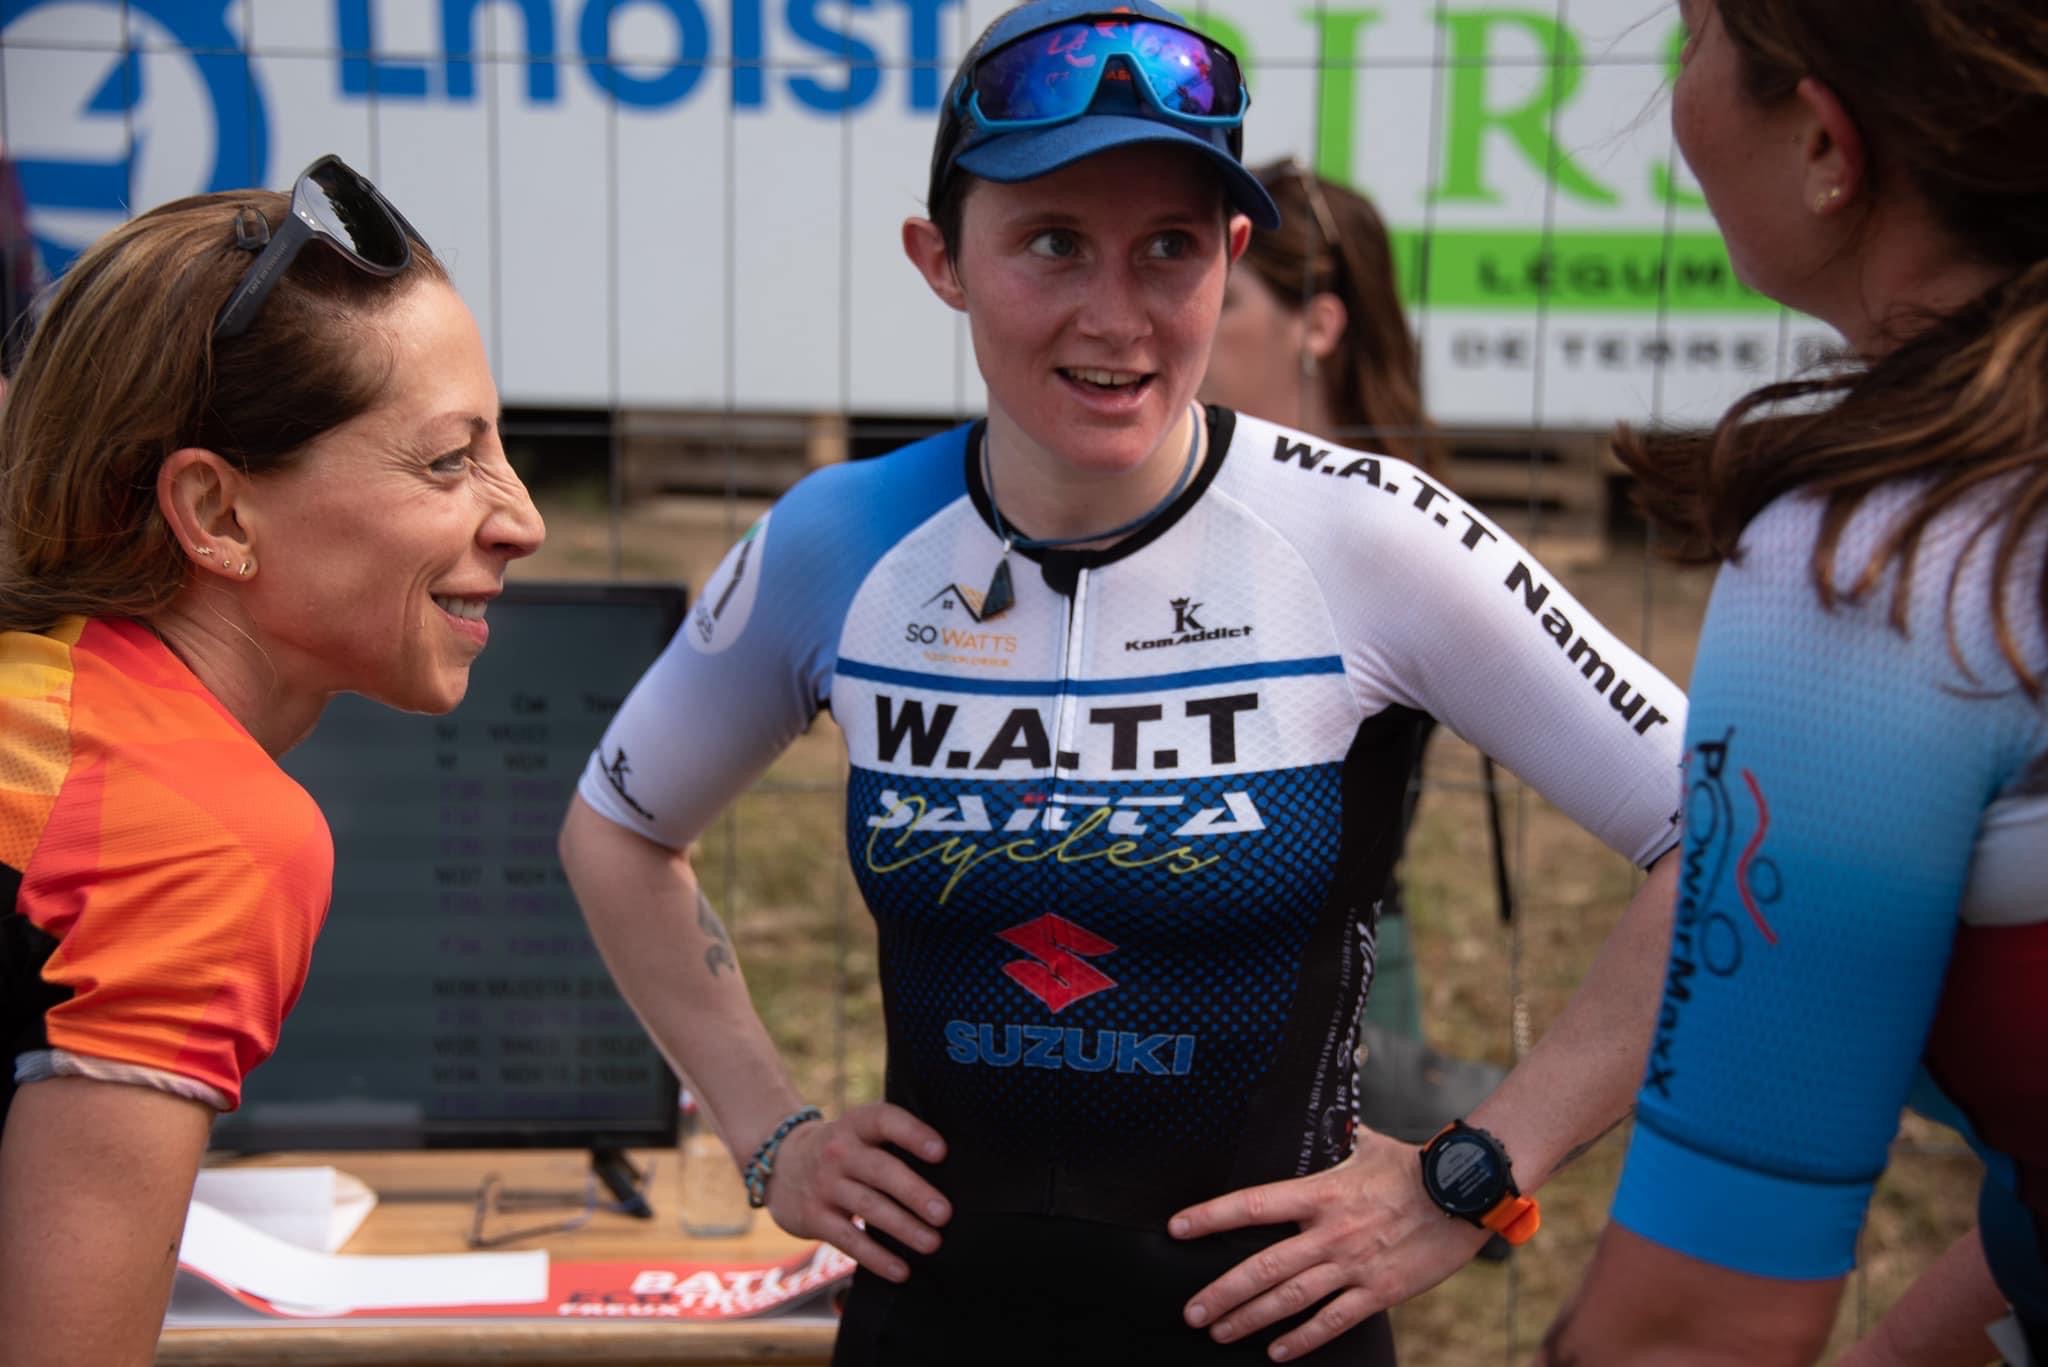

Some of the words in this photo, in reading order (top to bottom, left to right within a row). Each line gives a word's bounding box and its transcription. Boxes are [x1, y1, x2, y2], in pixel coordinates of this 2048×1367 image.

[905, 622, 938, 645] SO
[941, 625, 1017, 653] WATTS
[1504, 560, 1668, 736] Namur
[875, 692, 1258, 770] W.A.T.T
[866, 795, 1220, 904] Cycles
[944, 1020, 1196, 1076] SUZUKI
